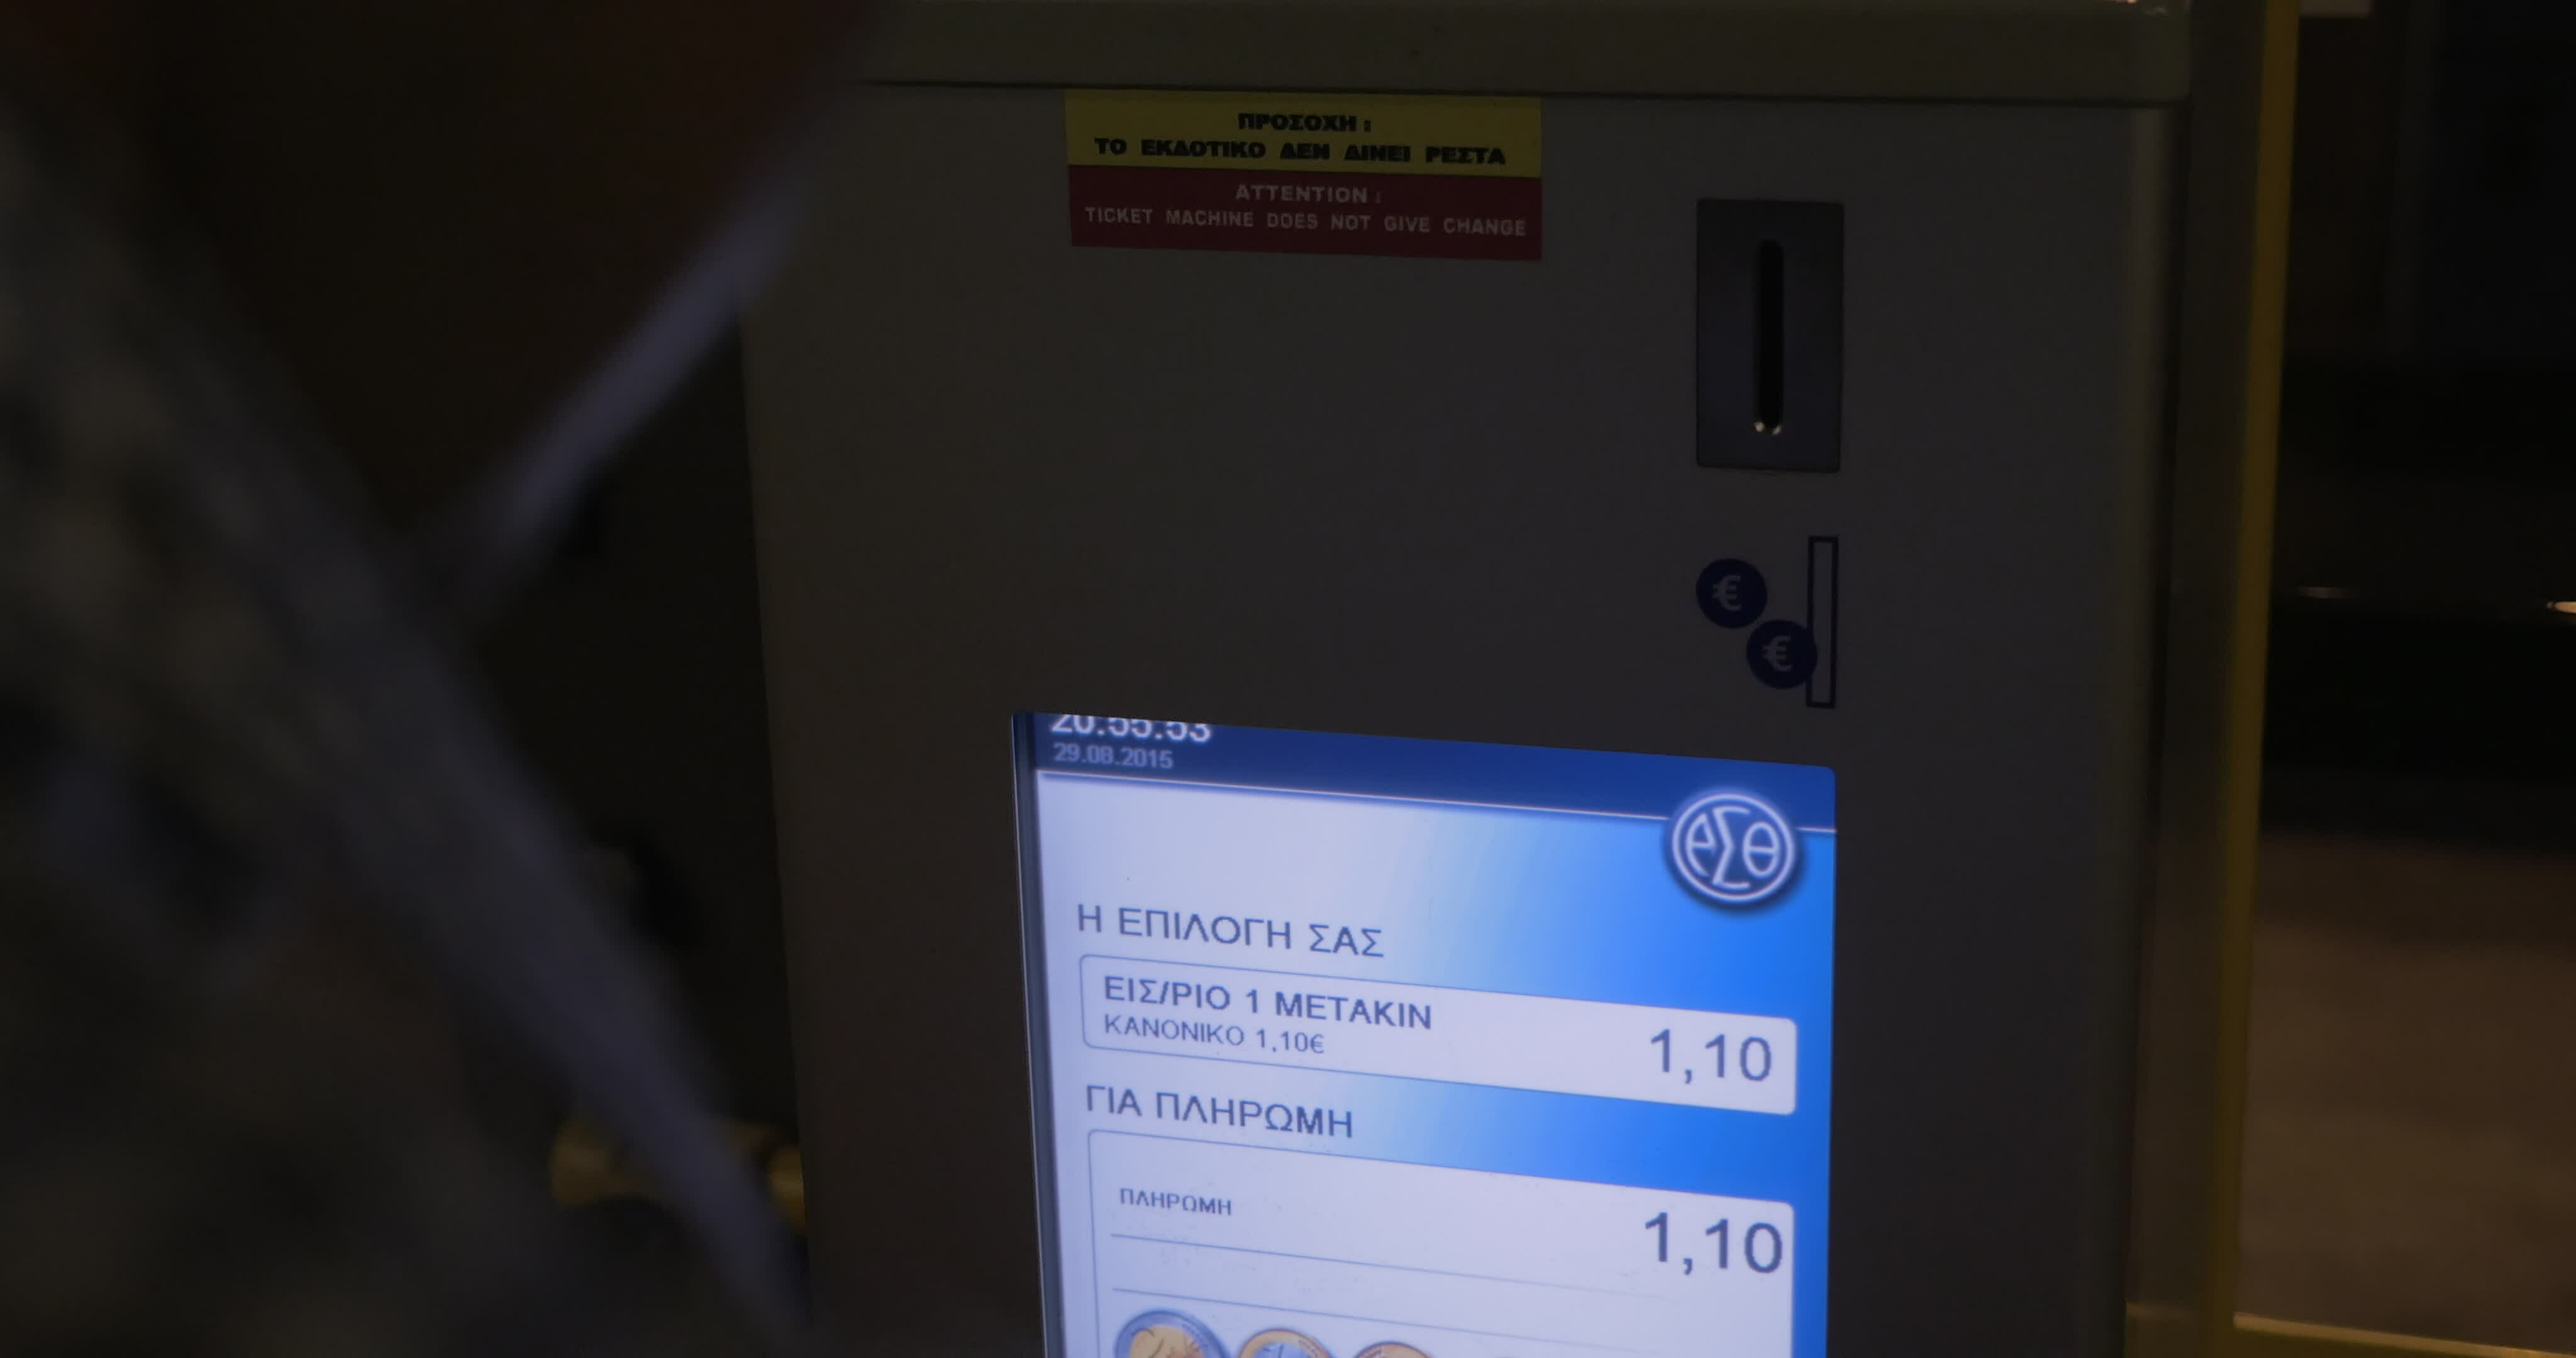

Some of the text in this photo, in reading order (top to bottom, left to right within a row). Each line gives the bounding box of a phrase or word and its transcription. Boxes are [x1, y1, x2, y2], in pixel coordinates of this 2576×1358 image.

[1238, 113, 1357, 132] ΠΡΟΣΟΧΗ
[1094, 138, 1506, 164] ΤΟ ΕΚΔΟΤΙΚΟ ΔΕΝ ΔΙΝΕΙ ΡΕΣΤΑ
[1235, 184, 1368, 204] ATTENTION
[1085, 207, 1526, 236] TICKET MACHINE DOES NOT GIVE CHANGE
[1053, 742, 1174, 770] 29.08.2015
[1077, 903, 1384, 958] Η ΕΠΙΛΟΓΗ ΣΑΣ
[1104, 976, 1432, 1030] ΕΙΣ/ΡΙΟ 1 ΜΕΤΑΚΙΝ
[1104, 1013, 1324, 1054] ΚΑΝΟΝΙΚΟ 1,10€
[1649, 1029, 1772, 1084] 1,10
[1086, 1085, 1353, 1139] ΓΙΑ ΠΛΗΡΩΜΗ
[1119, 1188, 1232, 1217] ΠΛΗΡΩΜΗ
[1643, 1212, 1784, 1276] 1,10
